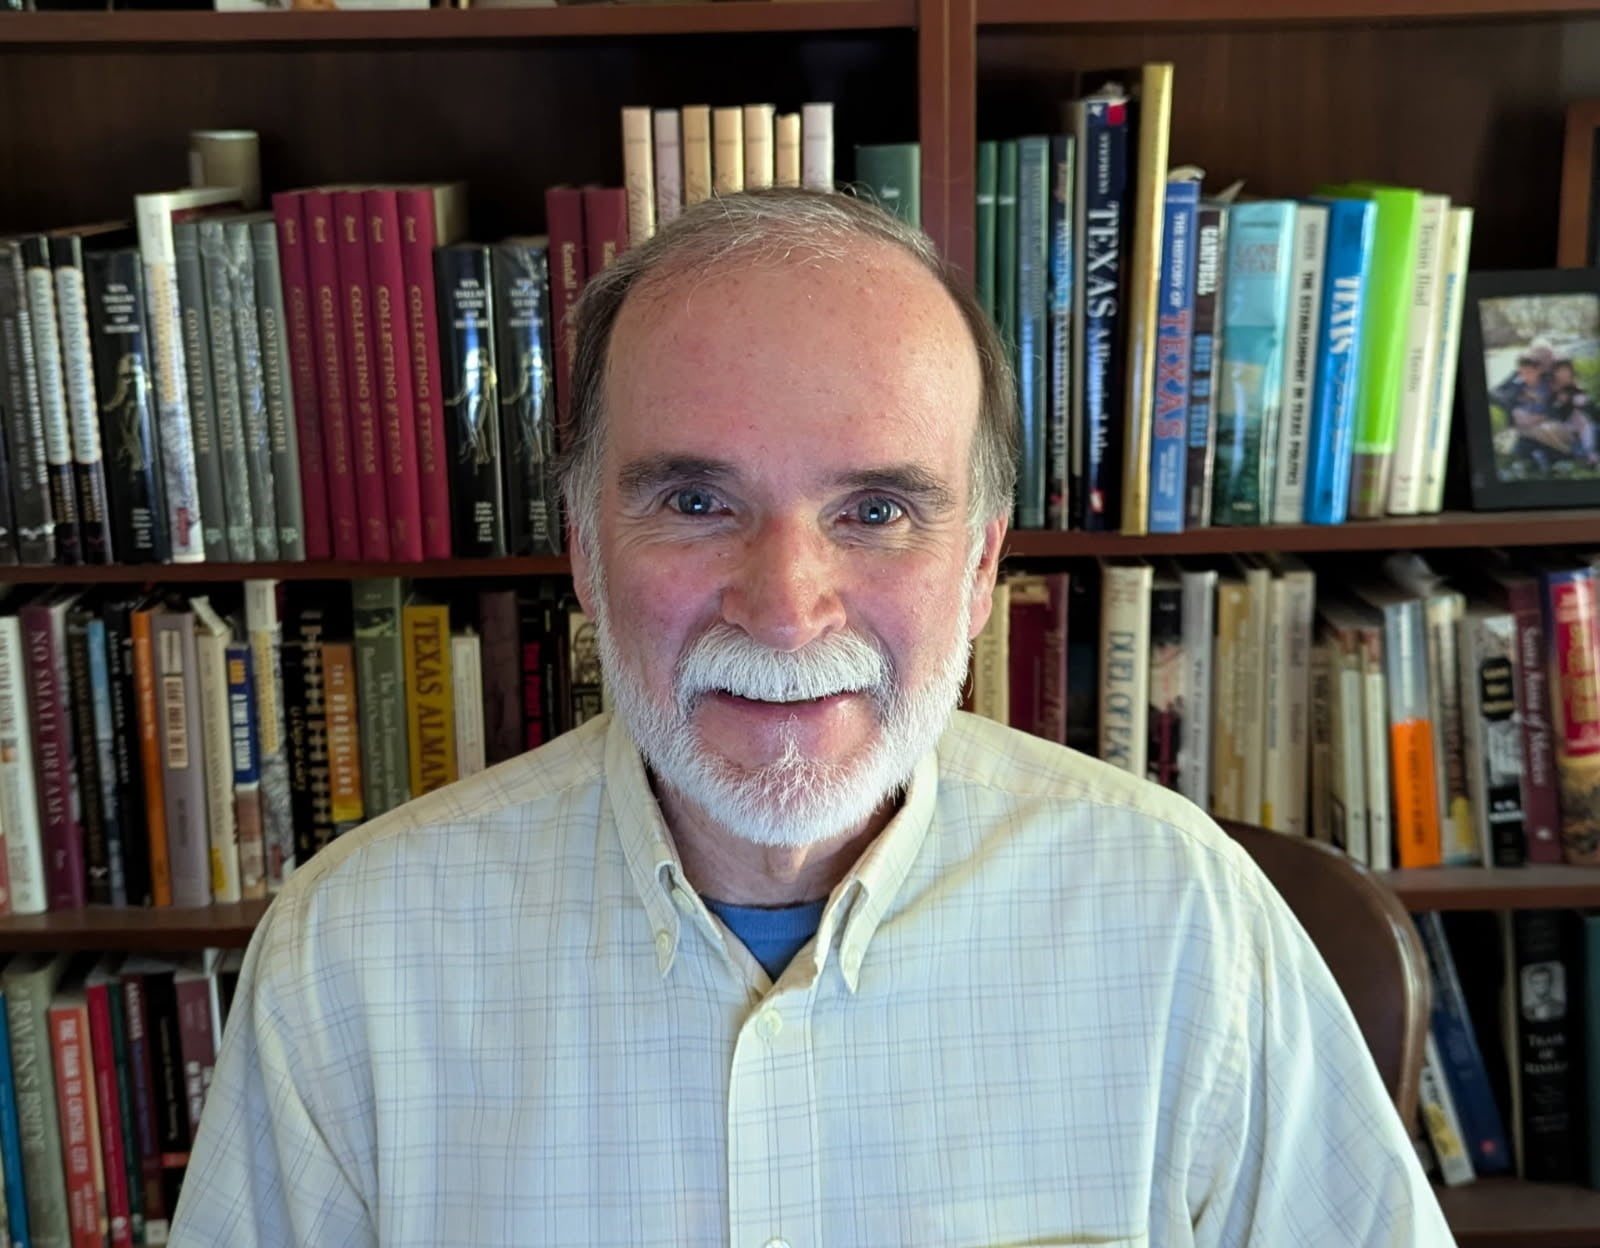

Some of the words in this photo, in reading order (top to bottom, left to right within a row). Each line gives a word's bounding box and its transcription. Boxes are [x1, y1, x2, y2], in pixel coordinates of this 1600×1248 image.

[1098, 132, 1111, 195] STEPHENS
[1173, 211, 1187, 236] THE
[563, 241, 576, 289] Kendall
[1088, 201, 1120, 318] TEXAS
[1172, 239, 1186, 288] HISTORY
[1198, 226, 1218, 295] CAMPBELL
[1302, 271, 1315, 290] THE
[1170, 290, 1183, 308] OF
[1329, 276, 1360, 354] TEXAS
[265, 308, 280, 395] CONTESTED
[321, 286, 340, 398] COLLECTING
[351, 286, 369, 398] COLLECTING
[1295, 295, 1313, 382] ESTABLISHMENT
[71, 356, 87, 394] AND
[186, 308, 202, 395] CONTESTED
[195, 401, 209, 454] EMPIRE
[377, 286, 396, 398] COLLECTING
[390, 417, 403, 475] TEXAS
[411, 286, 429, 397] COLLECTING
[422, 416, 436, 474] TEXAS
[1156, 309, 1189, 440] TEXAS
[272, 401, 286, 454] EMPIRE
[1290, 403, 1303, 436] TEXAS
[32, 629, 48, 662] NO
[413, 616, 443, 696] TEXAS
[1107, 631, 1135, 689] DUEL
[1524, 626, 1540, 668] Santa
[37, 667, 56, 732] SMALL
[983, 639, 997, 718] Houston
[1108, 693, 1133, 723] OF
[1527, 671, 1543, 710] Anna
[41, 741, 64, 826] DREAMS
[12, 1001, 40, 1088] RAVEN'S
[20, 1091, 45, 1152] BRIDE
